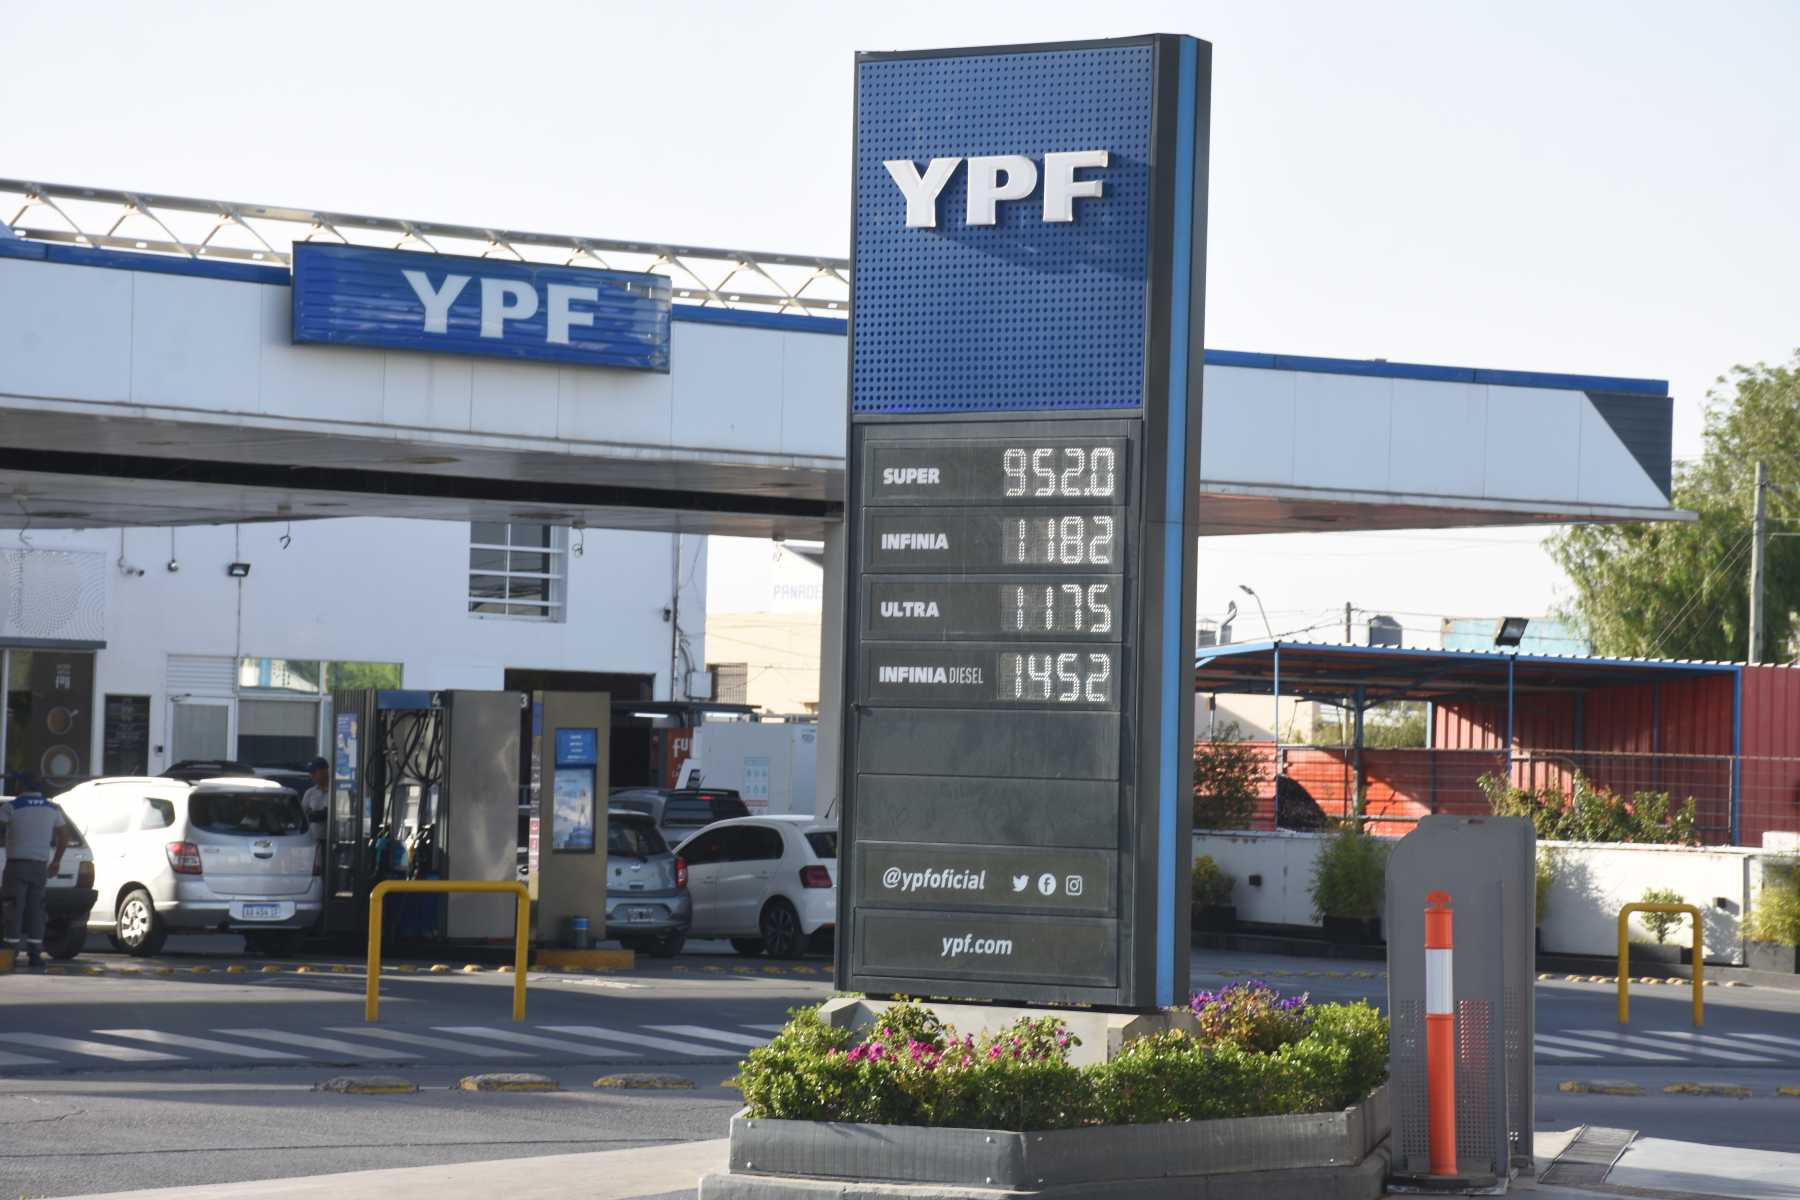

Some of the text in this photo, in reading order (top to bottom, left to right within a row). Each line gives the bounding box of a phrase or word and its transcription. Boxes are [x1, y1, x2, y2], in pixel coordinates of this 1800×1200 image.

[883, 149, 1110, 229] YPF
[401, 269, 599, 345] YPF
[882, 467, 941, 485] SUPER
[881, 516, 1113, 565] INFINIA 1182
[880, 584, 1112, 633] ULTRA 1175
[519, 693, 528, 708] 3
[879, 653, 1112, 702] INFINIA DIESEL 1452
[882, 866, 986, 893] @ypfoficial
[940, 933, 1013, 957] ypf.com
